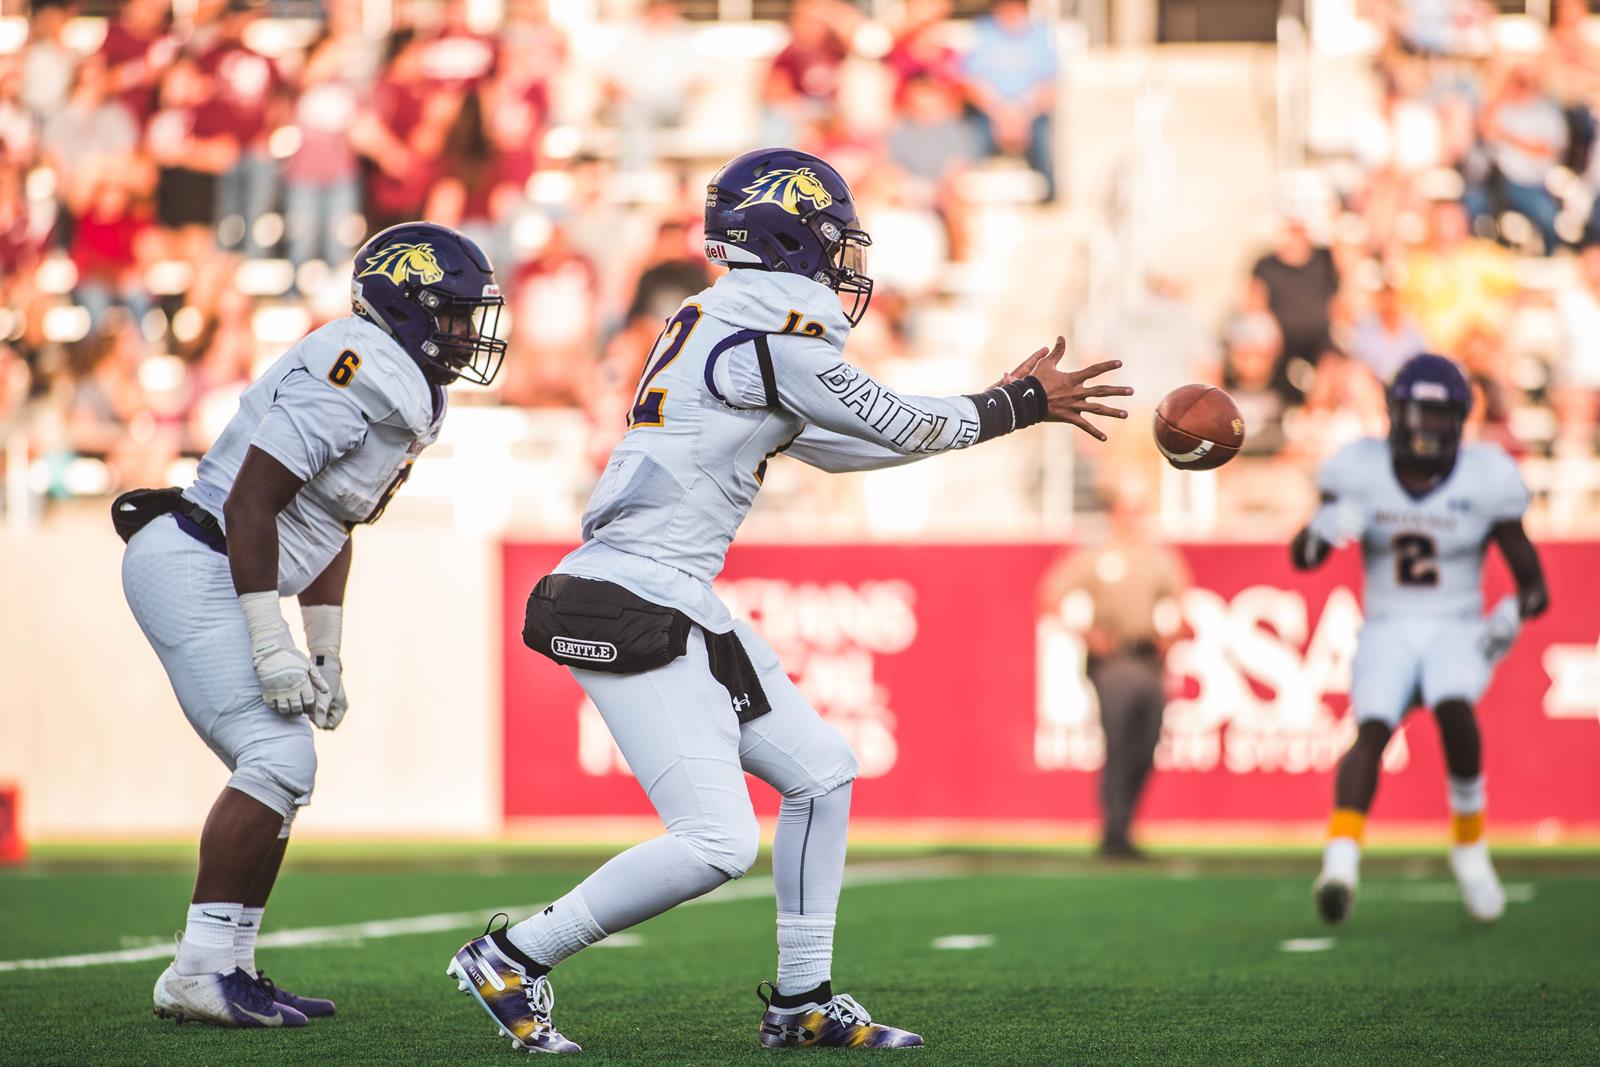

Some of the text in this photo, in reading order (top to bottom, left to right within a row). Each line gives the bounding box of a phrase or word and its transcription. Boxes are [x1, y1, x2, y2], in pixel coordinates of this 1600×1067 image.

[705, 245, 727, 259] dell
[327, 349, 362, 389] 6
[627, 303, 703, 432] 2
[816, 362, 978, 453] BATTLE
[1392, 532, 1441, 588] 2
[555, 640, 610, 659] BATTLE
